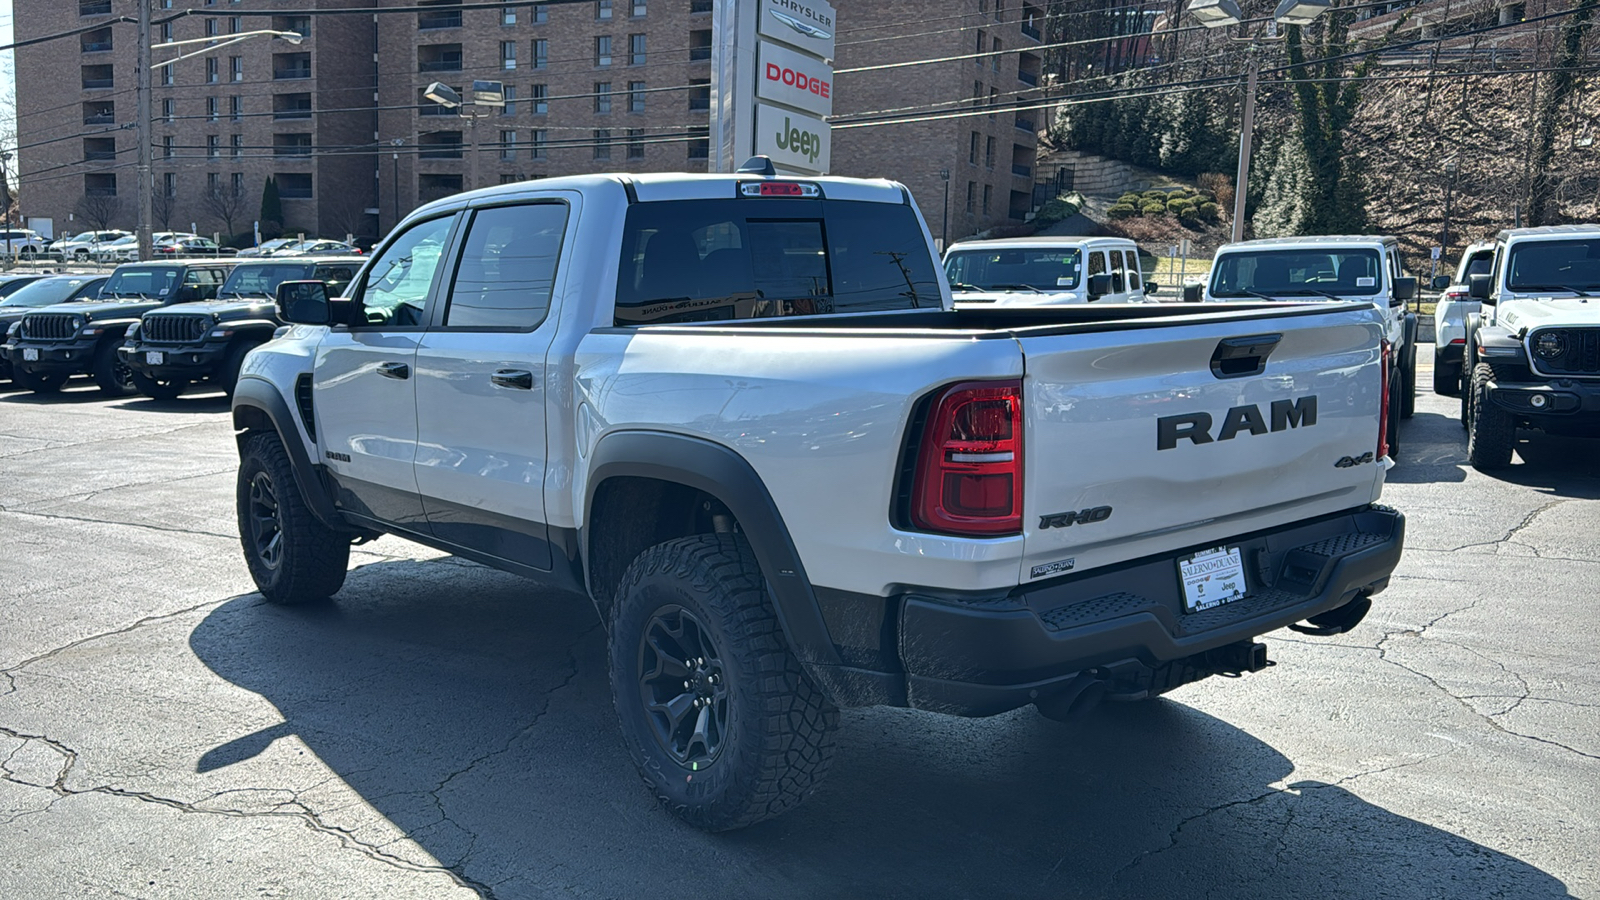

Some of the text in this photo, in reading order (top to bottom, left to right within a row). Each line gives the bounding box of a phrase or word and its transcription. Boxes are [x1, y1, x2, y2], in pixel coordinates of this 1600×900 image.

[766, 62, 830, 99] DODGE
[776, 116, 820, 164] Jeep
[1157, 395, 1317, 451] RAM
[325, 451, 351, 463] RAM
[1334, 452, 1374, 468] 4x4
[1038, 505, 1113, 529] RHO
[1182, 555, 1239, 577] SALERNO DUANE
[1222, 582, 1236, 591] Jeep
[1195, 593, 1244, 612] SALERNO DUANE
